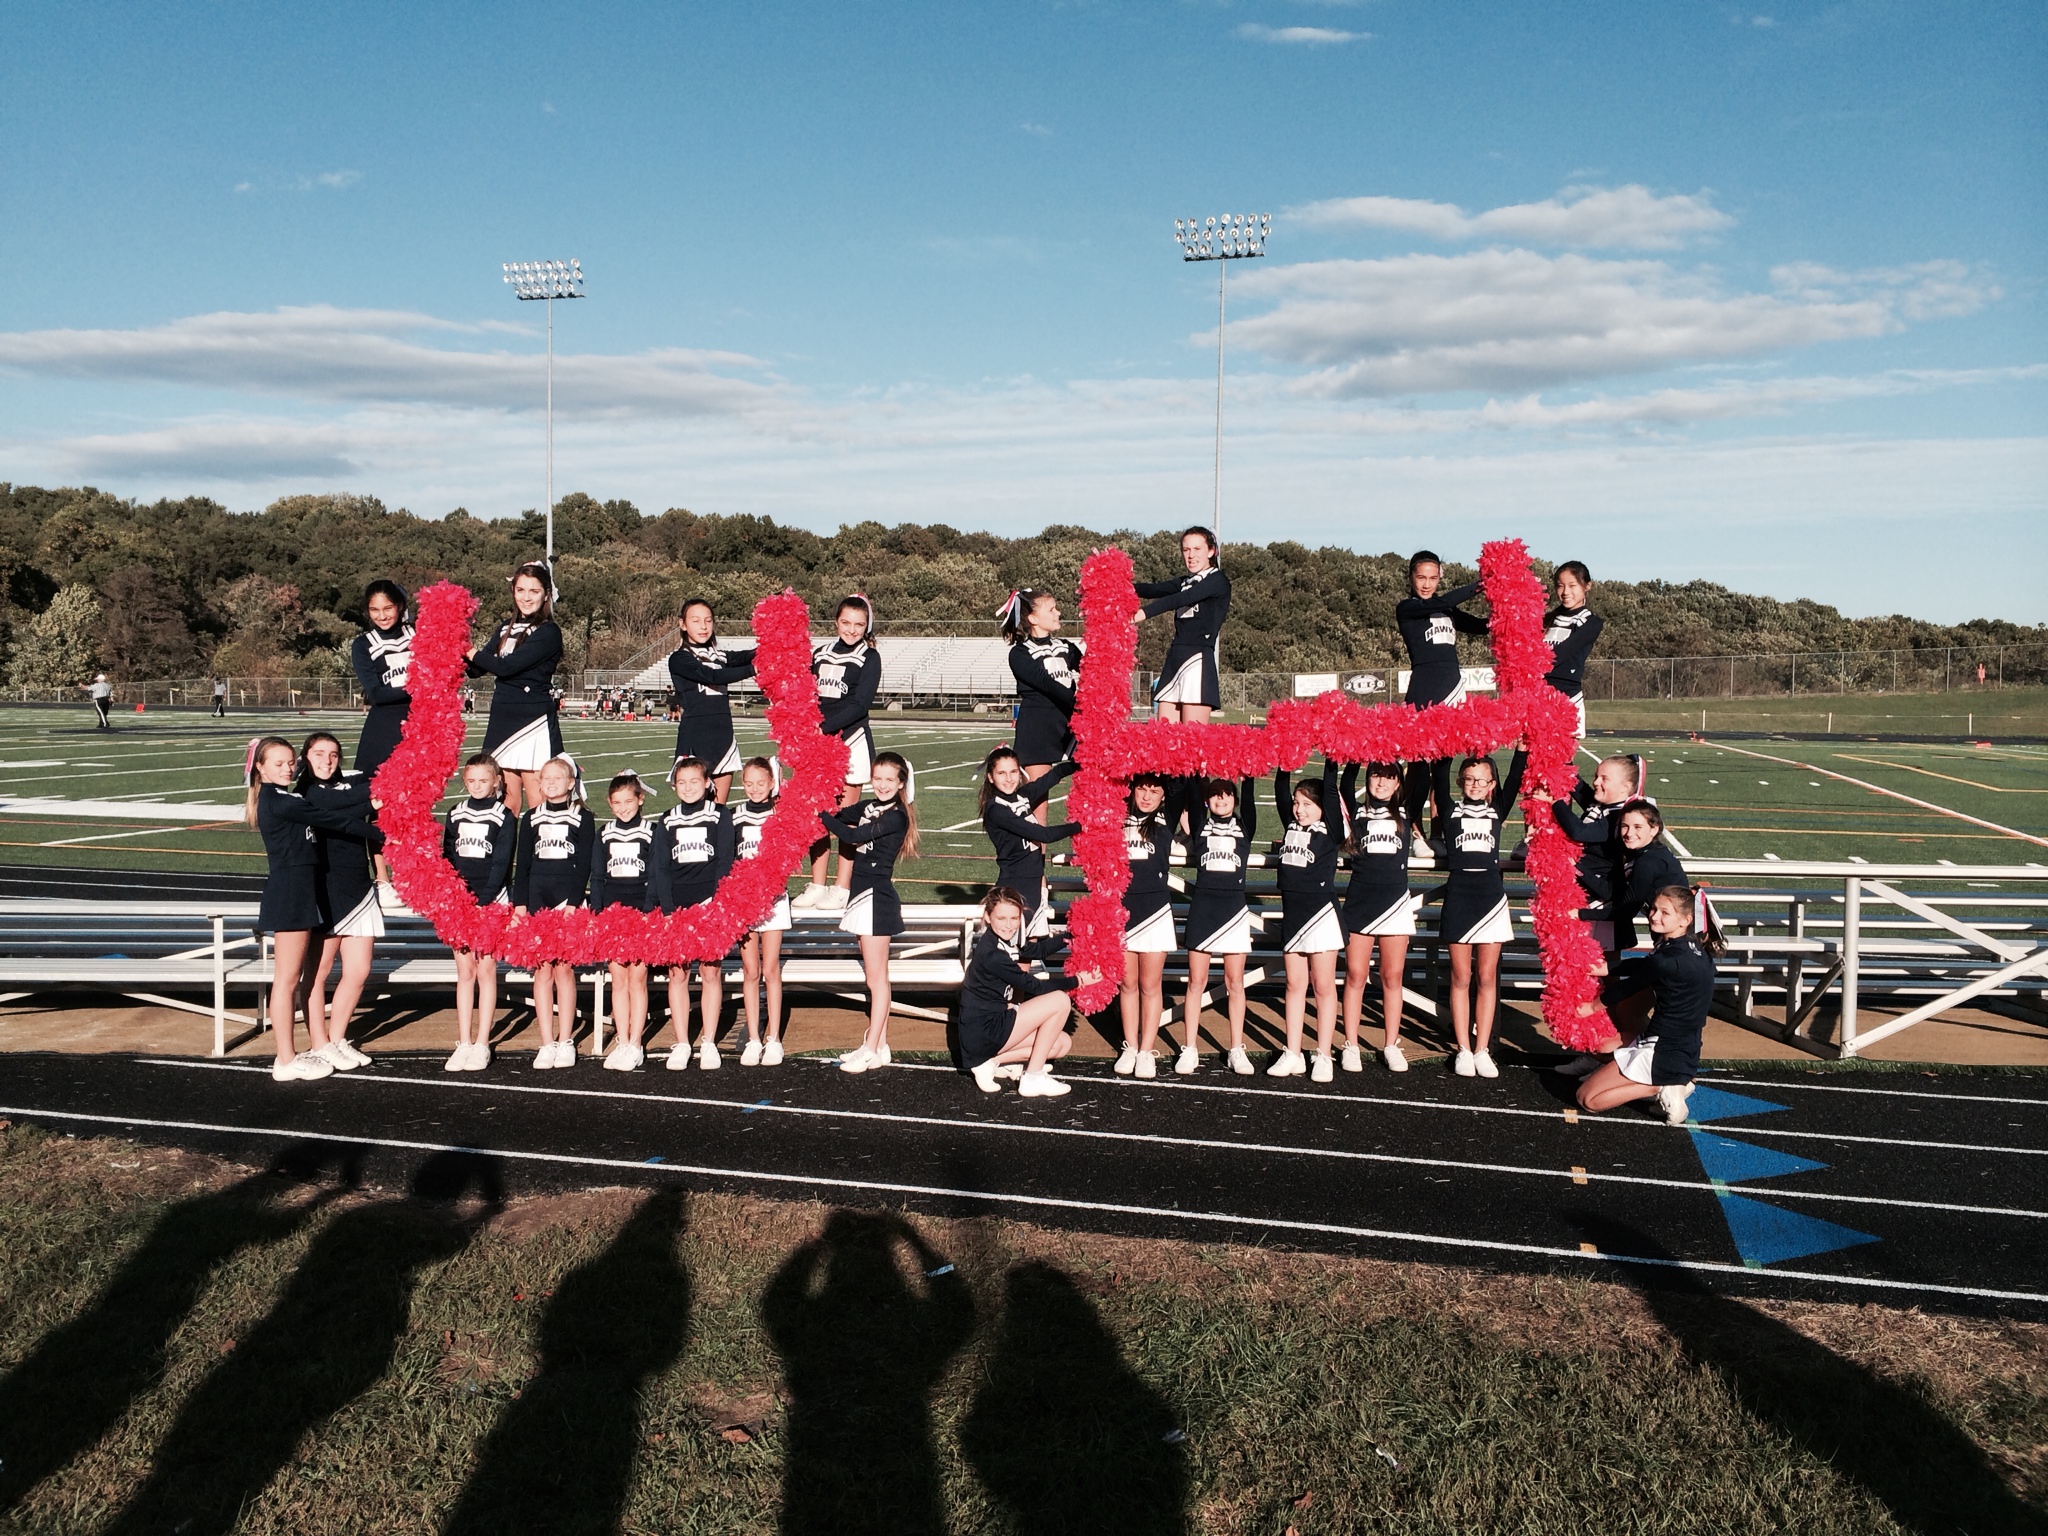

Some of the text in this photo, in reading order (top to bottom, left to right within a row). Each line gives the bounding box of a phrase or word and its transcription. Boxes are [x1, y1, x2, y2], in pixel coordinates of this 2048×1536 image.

[1425, 625, 1456, 642] HAWK
[382, 666, 409, 685] HAW
[455, 837, 492, 854] HAWKS
[535, 838, 574, 854] HAWKS
[738, 840, 759, 856] HAW
[1128, 839, 1155, 854] WKS
[1361, 834, 1402, 849] HAWKS
[1455, 832, 1495, 848] HAWKS
[672, 841, 714, 859] HAWKS
[1201, 849, 1241, 867] HAWKS
[1279, 844, 1315, 863] HAWKS
[607, 856, 646, 873] HAWKS
